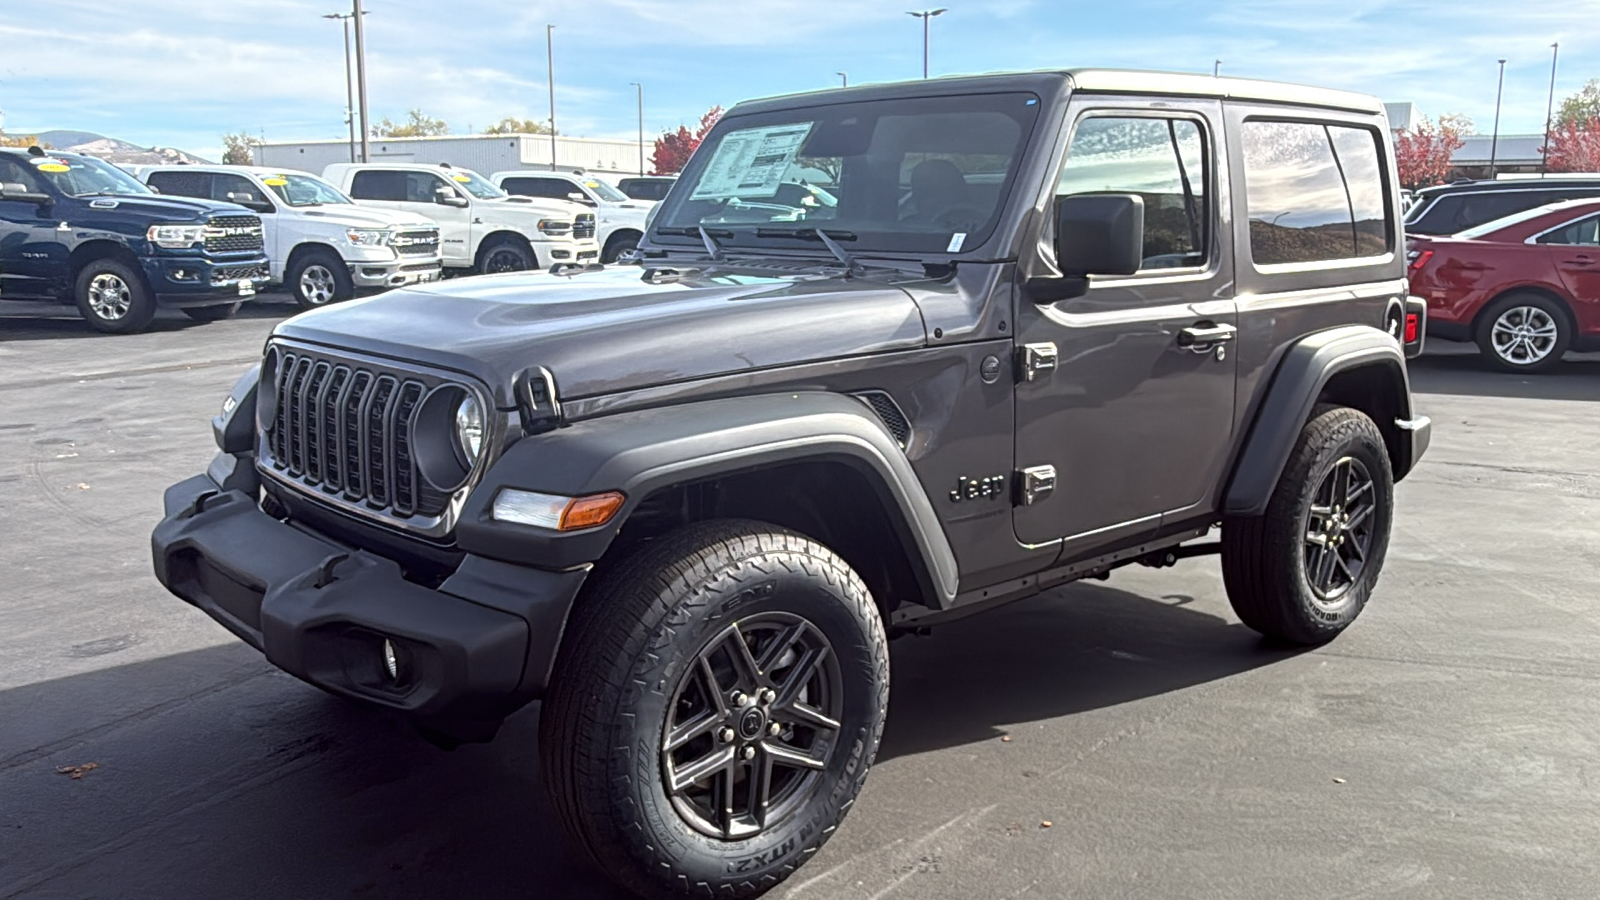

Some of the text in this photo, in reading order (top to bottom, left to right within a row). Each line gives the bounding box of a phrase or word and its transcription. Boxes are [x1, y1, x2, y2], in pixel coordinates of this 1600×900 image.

[226, 227, 253, 236] RAM
[949, 476, 1003, 503] Jeep
[737, 738, 864, 873] ROADIAN HTX2
